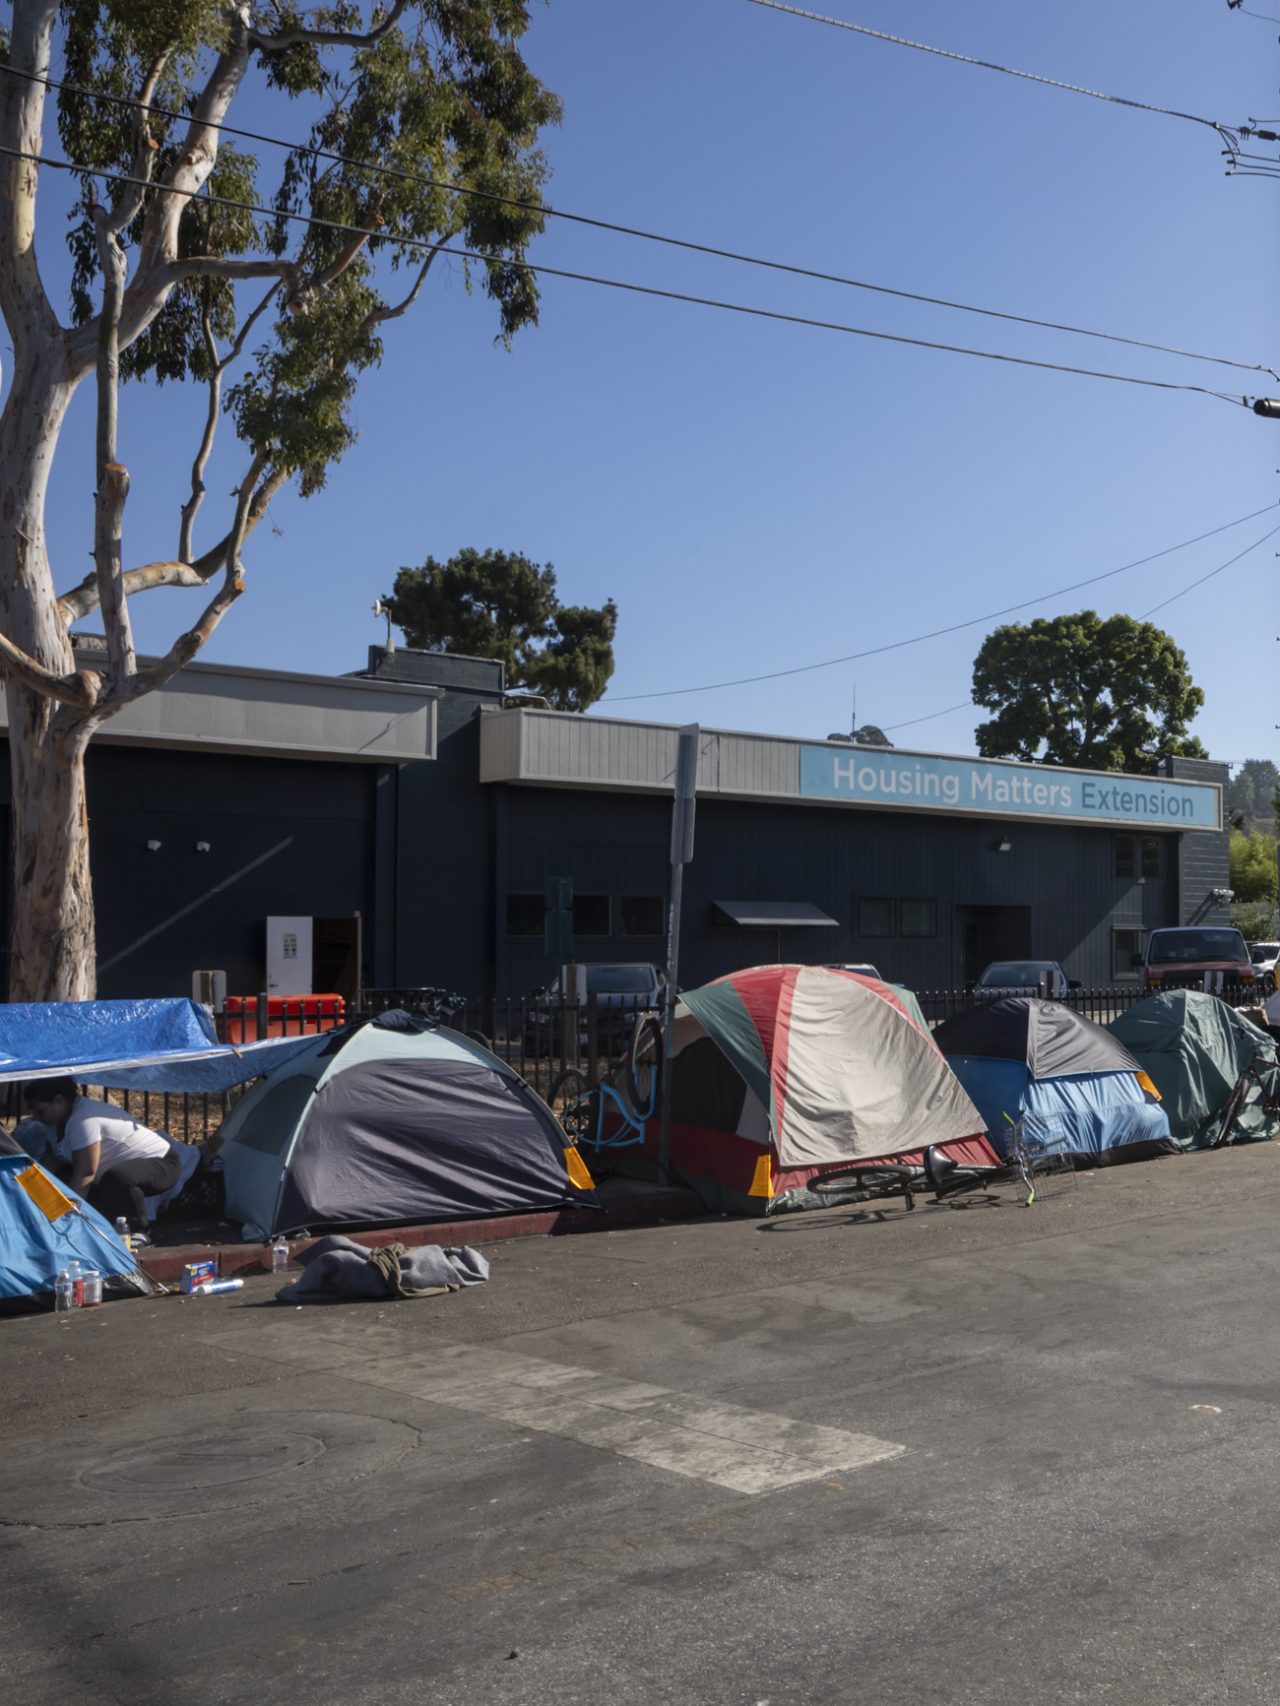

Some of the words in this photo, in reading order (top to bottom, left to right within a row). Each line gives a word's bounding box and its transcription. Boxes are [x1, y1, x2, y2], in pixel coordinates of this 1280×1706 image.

[833, 757, 960, 804] Housing
[971, 770, 1072, 807] Matters
[1081, 782, 1194, 817] Extension
